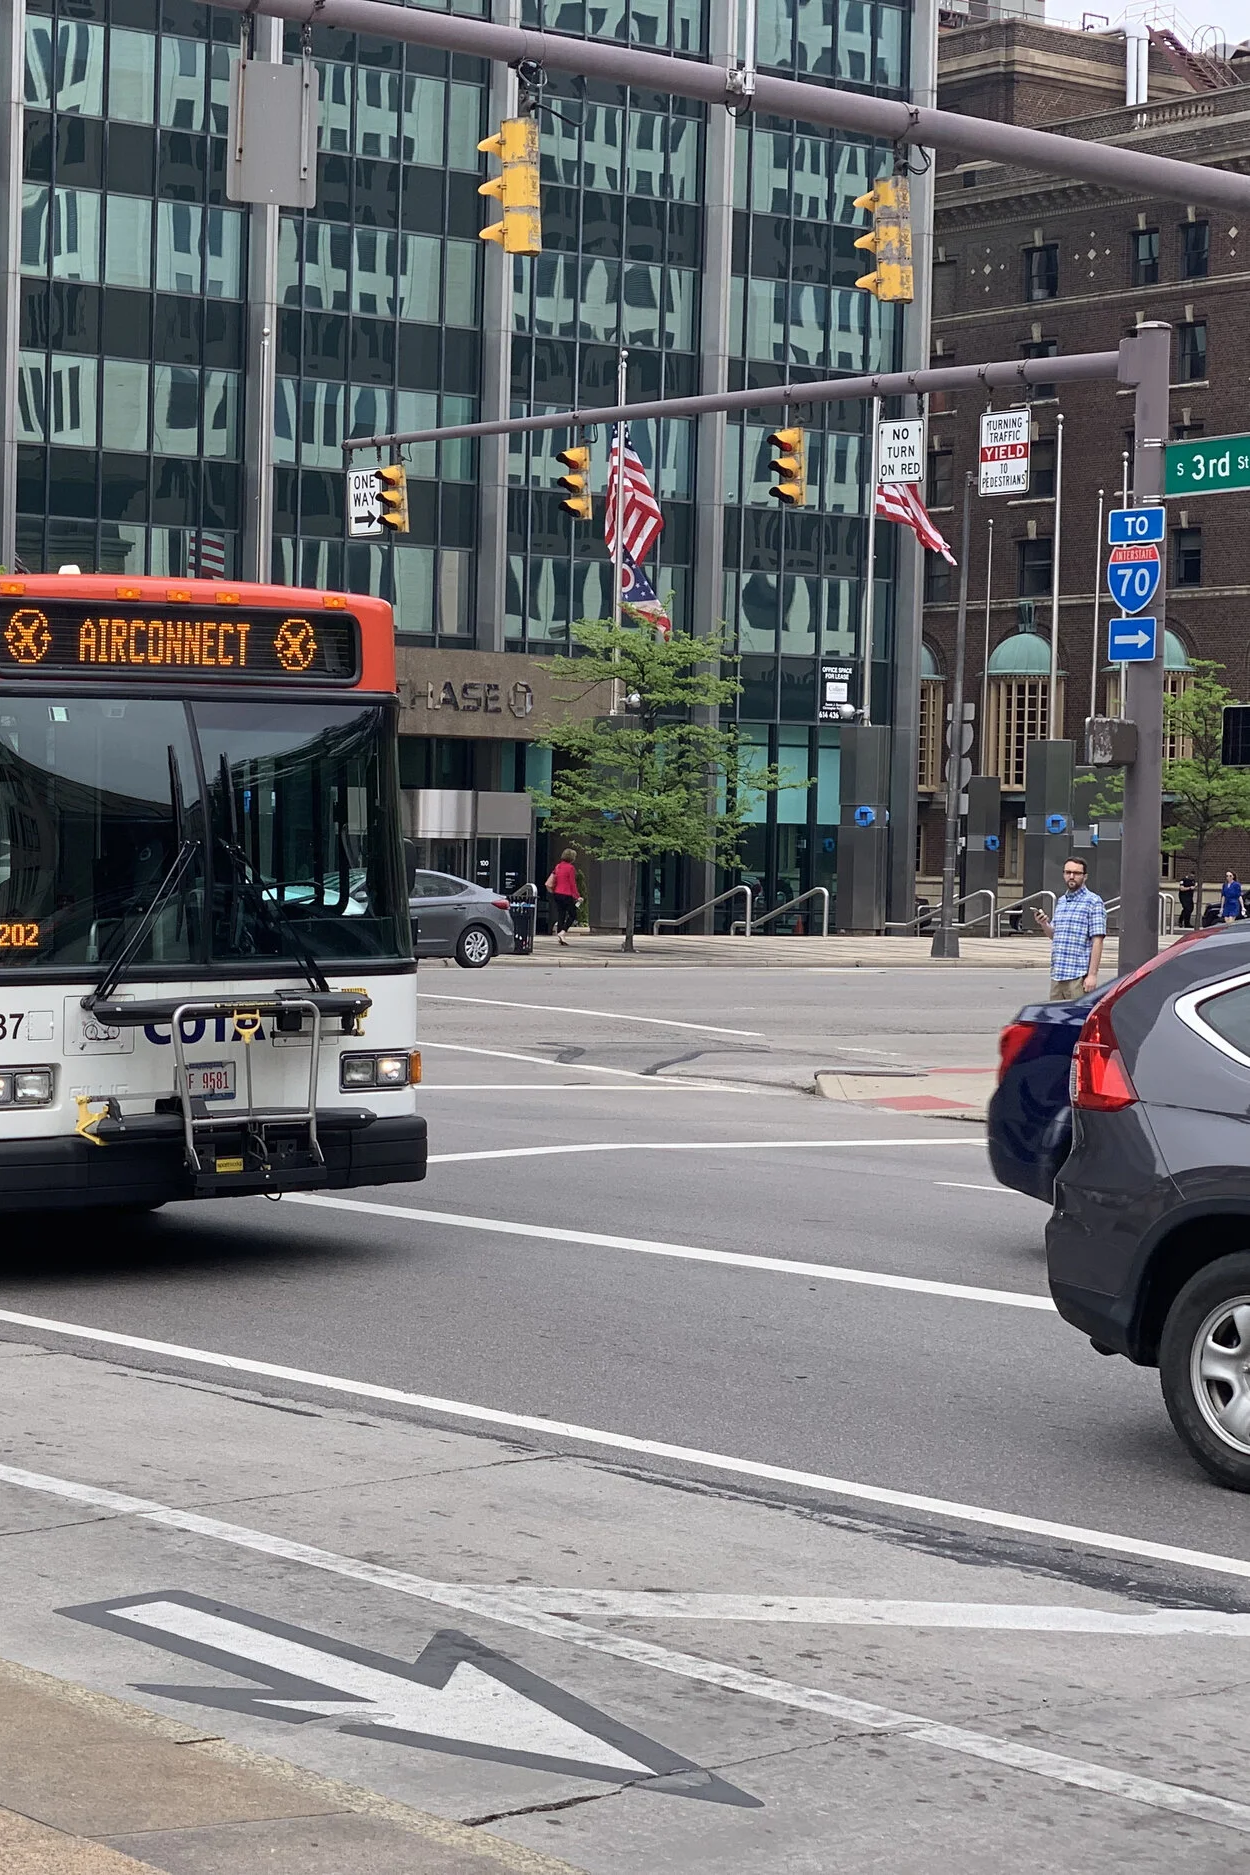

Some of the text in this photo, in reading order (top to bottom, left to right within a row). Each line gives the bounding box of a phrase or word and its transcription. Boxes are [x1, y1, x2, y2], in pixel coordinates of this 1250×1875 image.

[988, 416, 1023, 431] TURNING
[892, 428, 909, 441] NO
[990, 429, 1021, 443] TRAFFIC
[887, 445, 915, 458] TURN
[985, 445, 1025, 461] YIELD
[881, 462, 920, 476] ON RED
[1000, 463, 1008, 474] TO
[1177, 451, 1249, 480] S 3rd St
[354, 474, 376, 490] ONE
[982, 473, 1026, 488] PEDESTRIANS
[353, 492, 377, 507] WAY
[1124, 516, 1148, 536] TO
[1116, 549, 1153, 561] INTERSTATE
[1117, 567, 1150, 597] 70
[78, 617, 251, 667] AIRCONNECT
[202, 1071, 230, 1089] 9581
